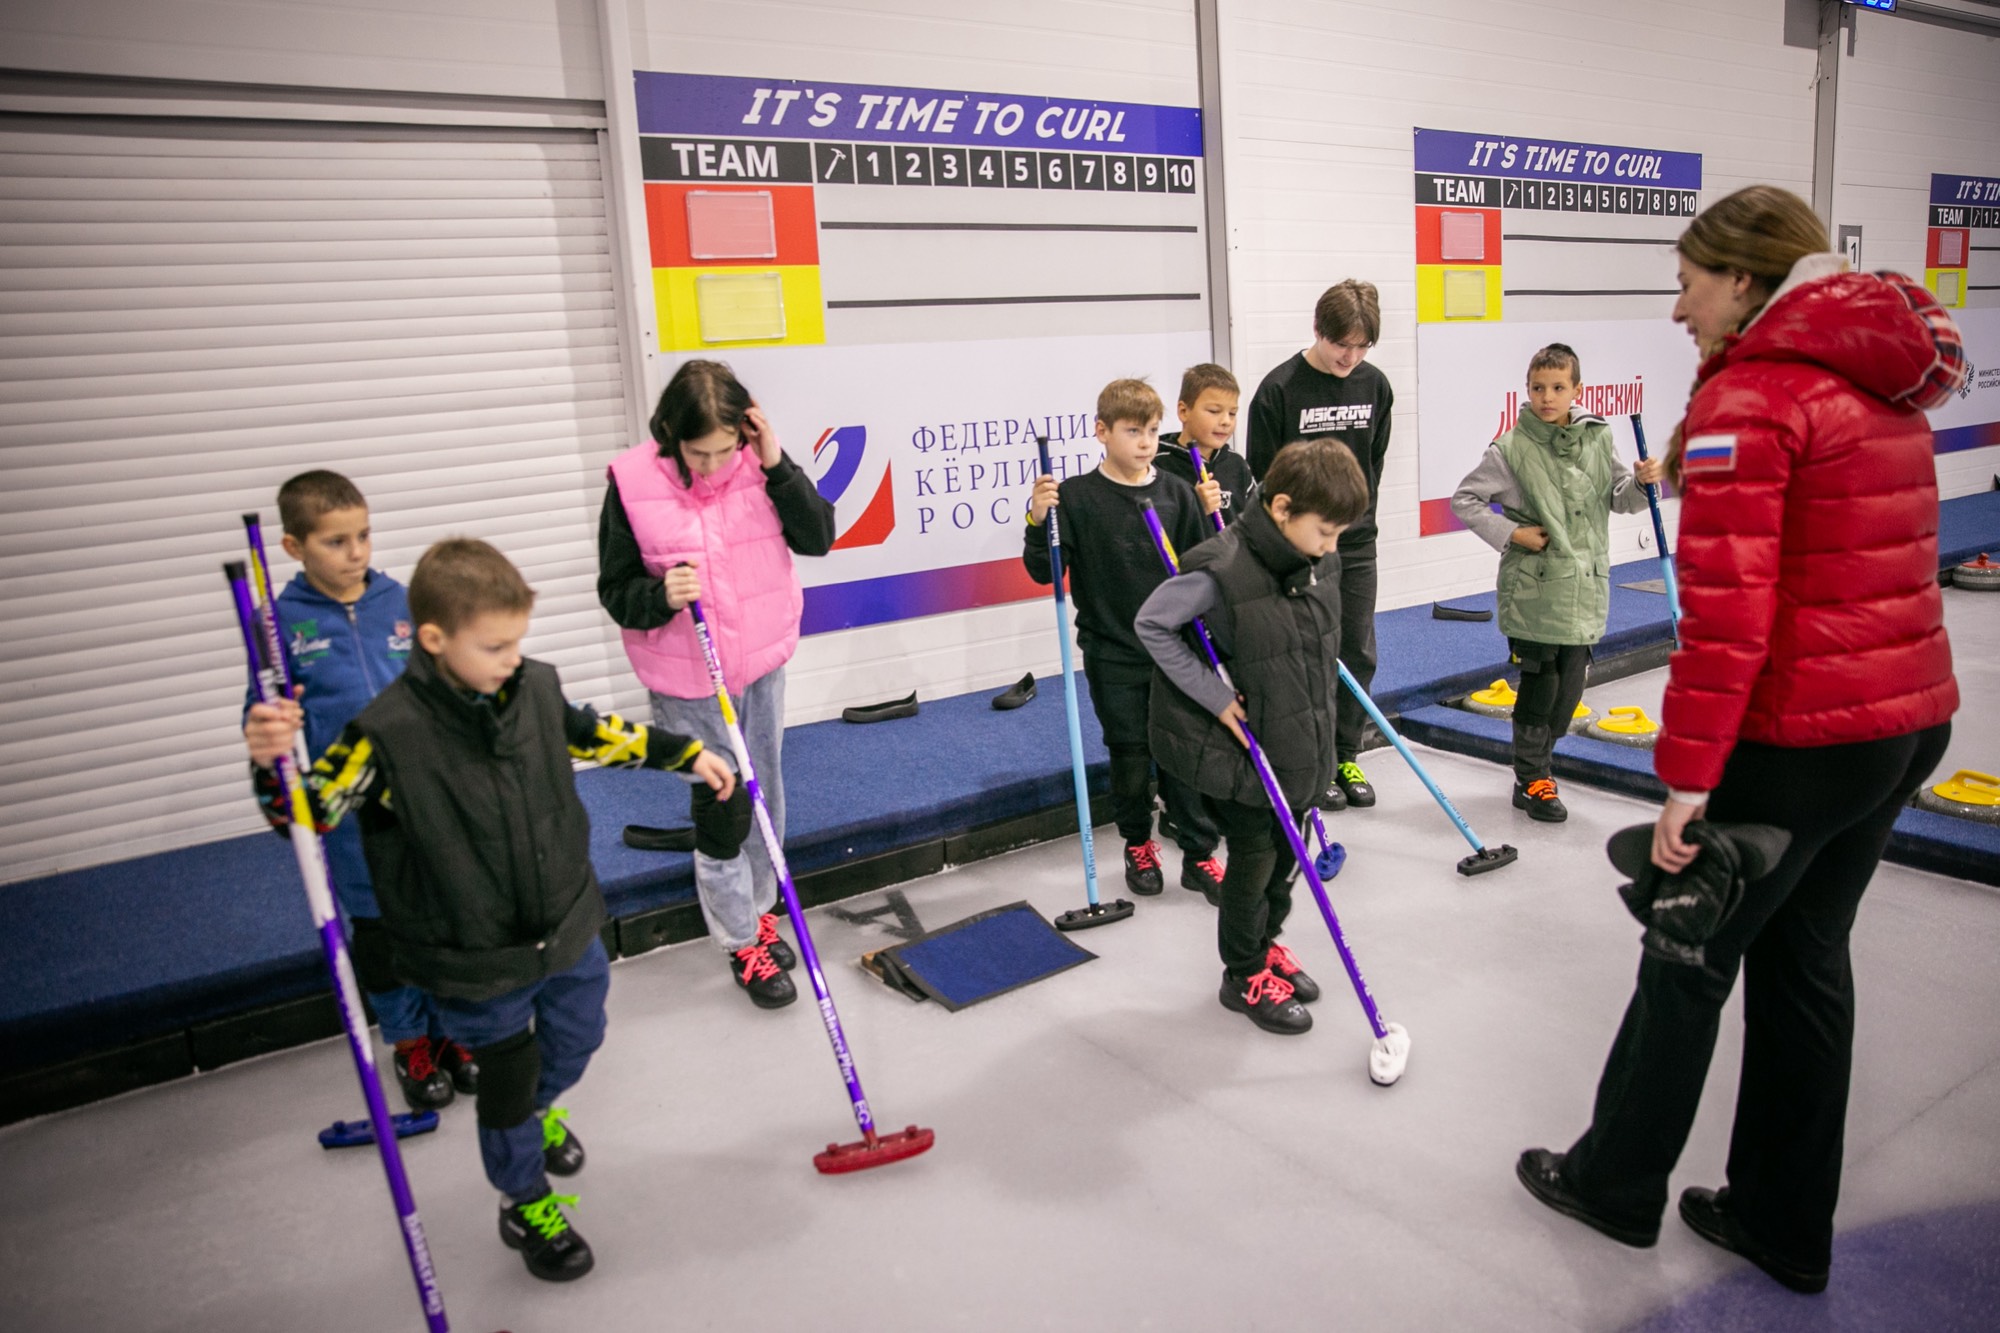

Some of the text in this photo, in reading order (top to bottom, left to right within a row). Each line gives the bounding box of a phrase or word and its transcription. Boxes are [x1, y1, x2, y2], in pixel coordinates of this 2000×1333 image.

[855, 94, 966, 134] TIME
[971, 100, 1024, 136] TO
[1035, 107, 1127, 143] CURL
[671, 141, 1194, 188] TEAM 1 2 3 4 5 6 7 8 9 10
[1523, 145, 1579, 174] TIME
[1582, 150, 1610, 175] TO
[1614, 154, 1662, 180] CURL
[1433, 178, 1695, 213] TEAM 1 2 3 4 5 6 7 8 9 10
[1937, 207, 1999, 225] TEAM 1 2
[1850, 241, 1857, 264] 1
